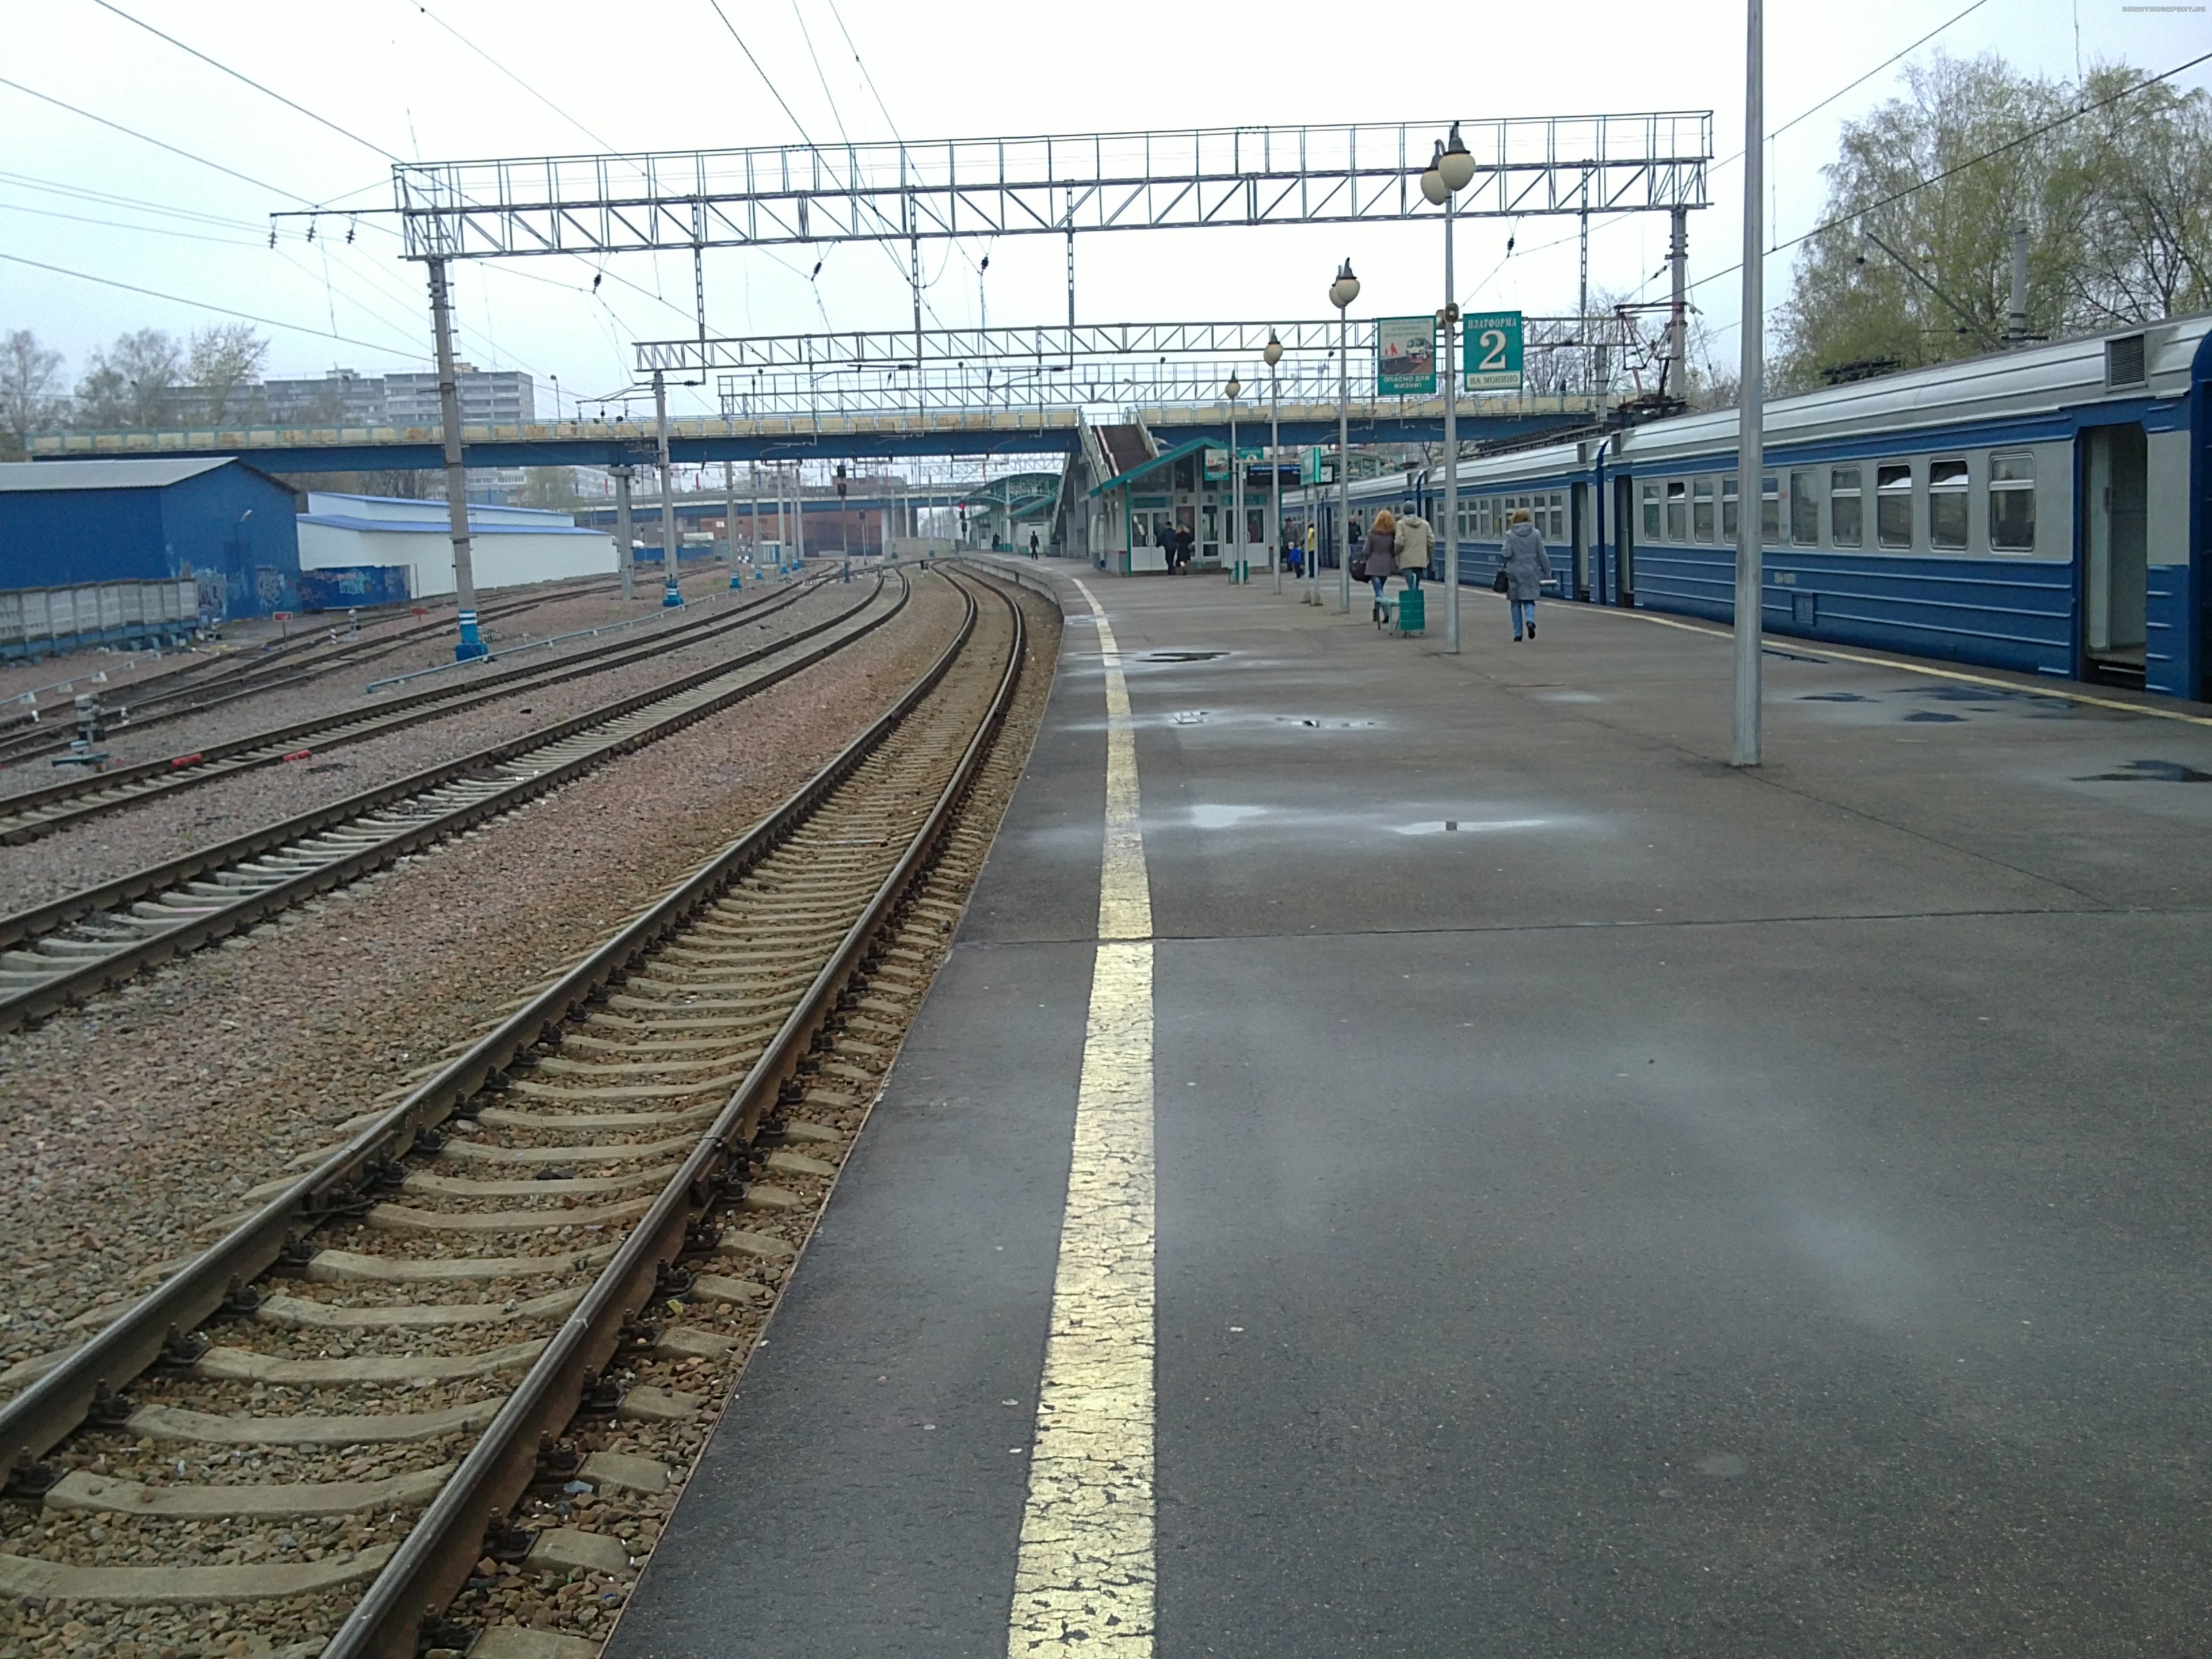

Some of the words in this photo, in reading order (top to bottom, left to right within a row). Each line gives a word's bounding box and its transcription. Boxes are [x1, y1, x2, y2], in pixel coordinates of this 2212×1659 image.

[1467, 318, 1517, 329] ПЛАТФОРМА
[1479, 329, 1507, 370] 2
[1469, 376, 1481, 385] НА
[1483, 375, 1518, 384] МОНИНО
